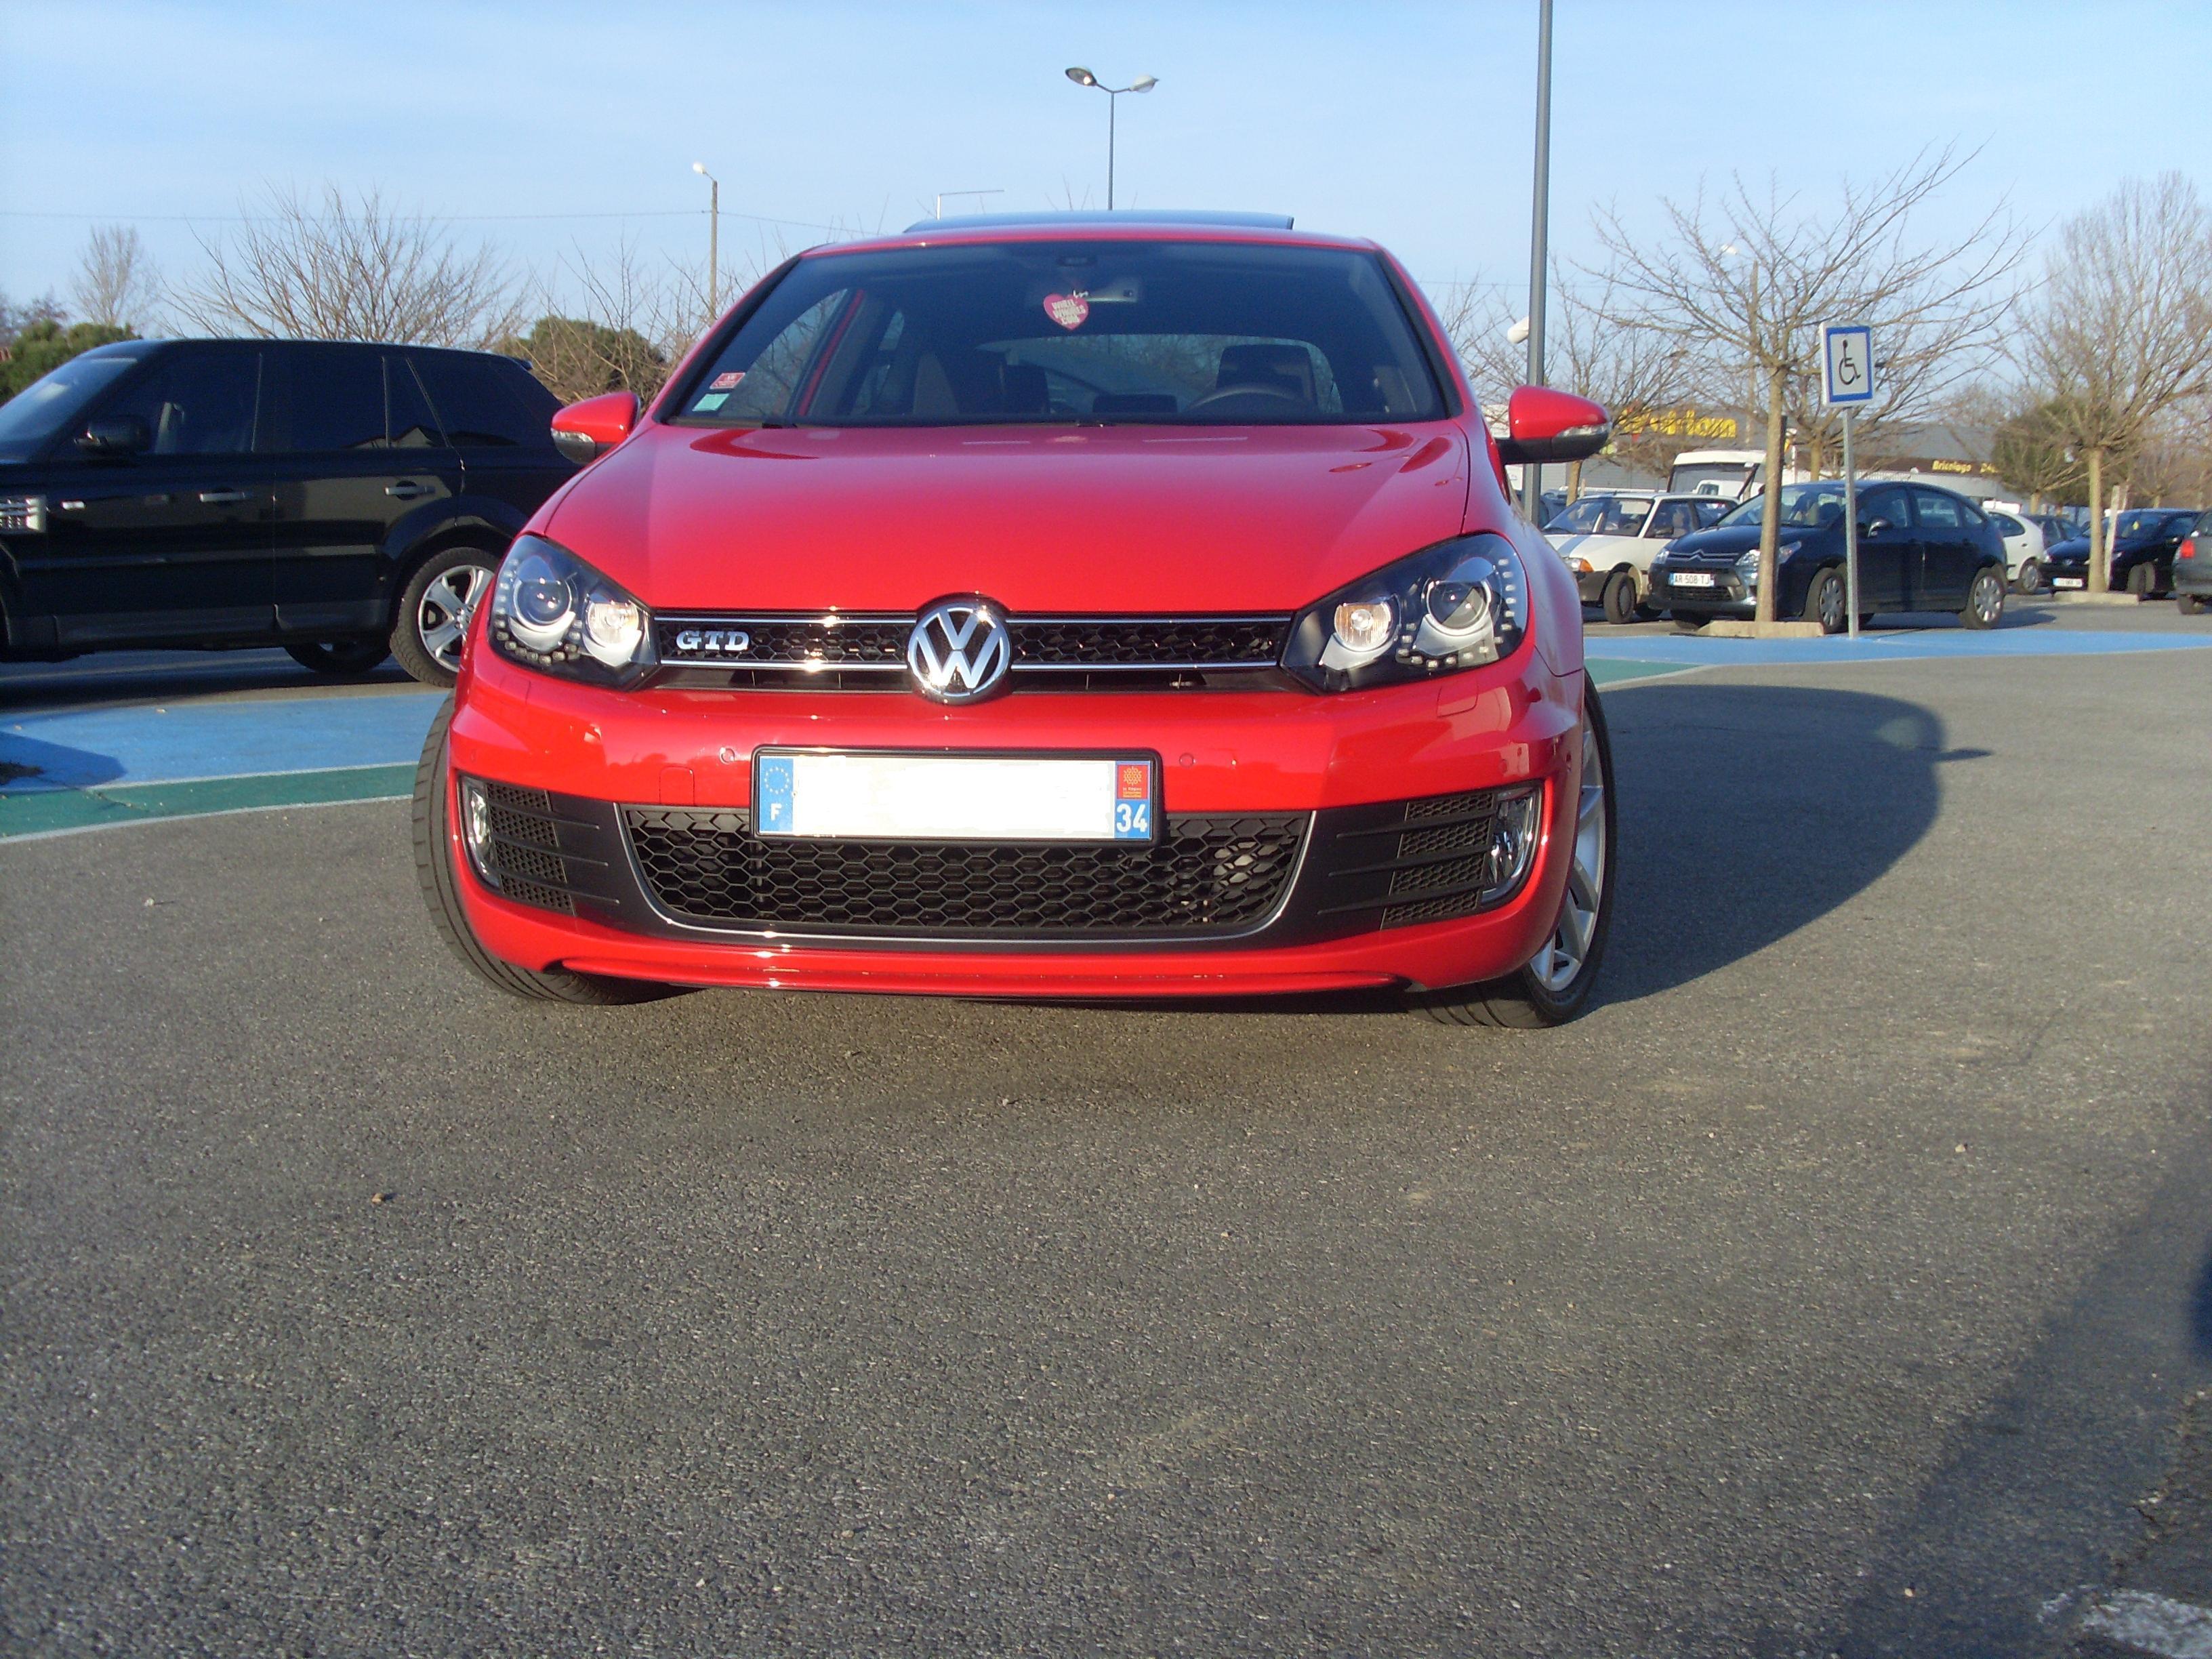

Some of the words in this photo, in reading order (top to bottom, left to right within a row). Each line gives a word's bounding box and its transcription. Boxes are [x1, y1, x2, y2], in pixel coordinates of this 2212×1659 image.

[676, 630, 750, 651] GTD
[771, 803, 782, 821] F
[1116, 803, 1147, 832] 34
